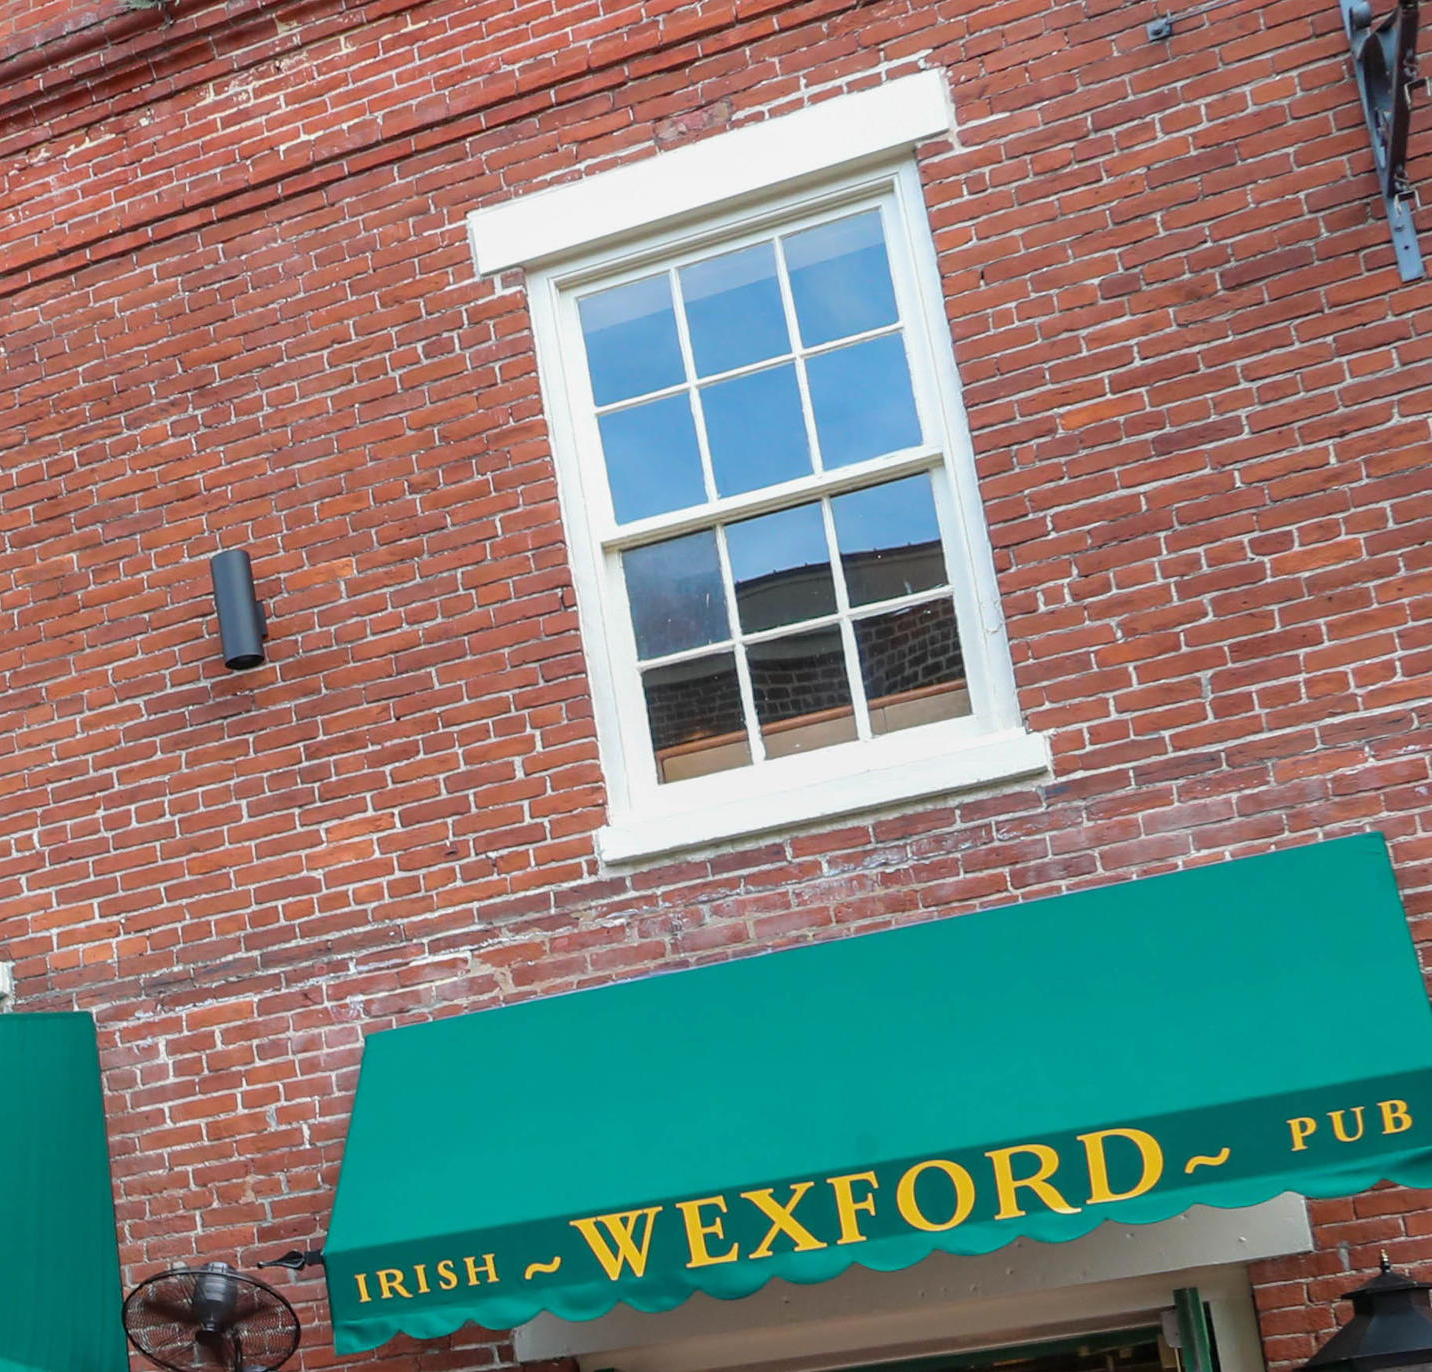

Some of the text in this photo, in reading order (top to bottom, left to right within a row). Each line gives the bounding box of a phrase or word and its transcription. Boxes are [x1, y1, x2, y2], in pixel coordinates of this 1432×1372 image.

[353, 1253, 500, 1303] IRISH
[569, 1128, 1164, 1282] WEXFORD
[1286, 1098, 1413, 1153] PUB
